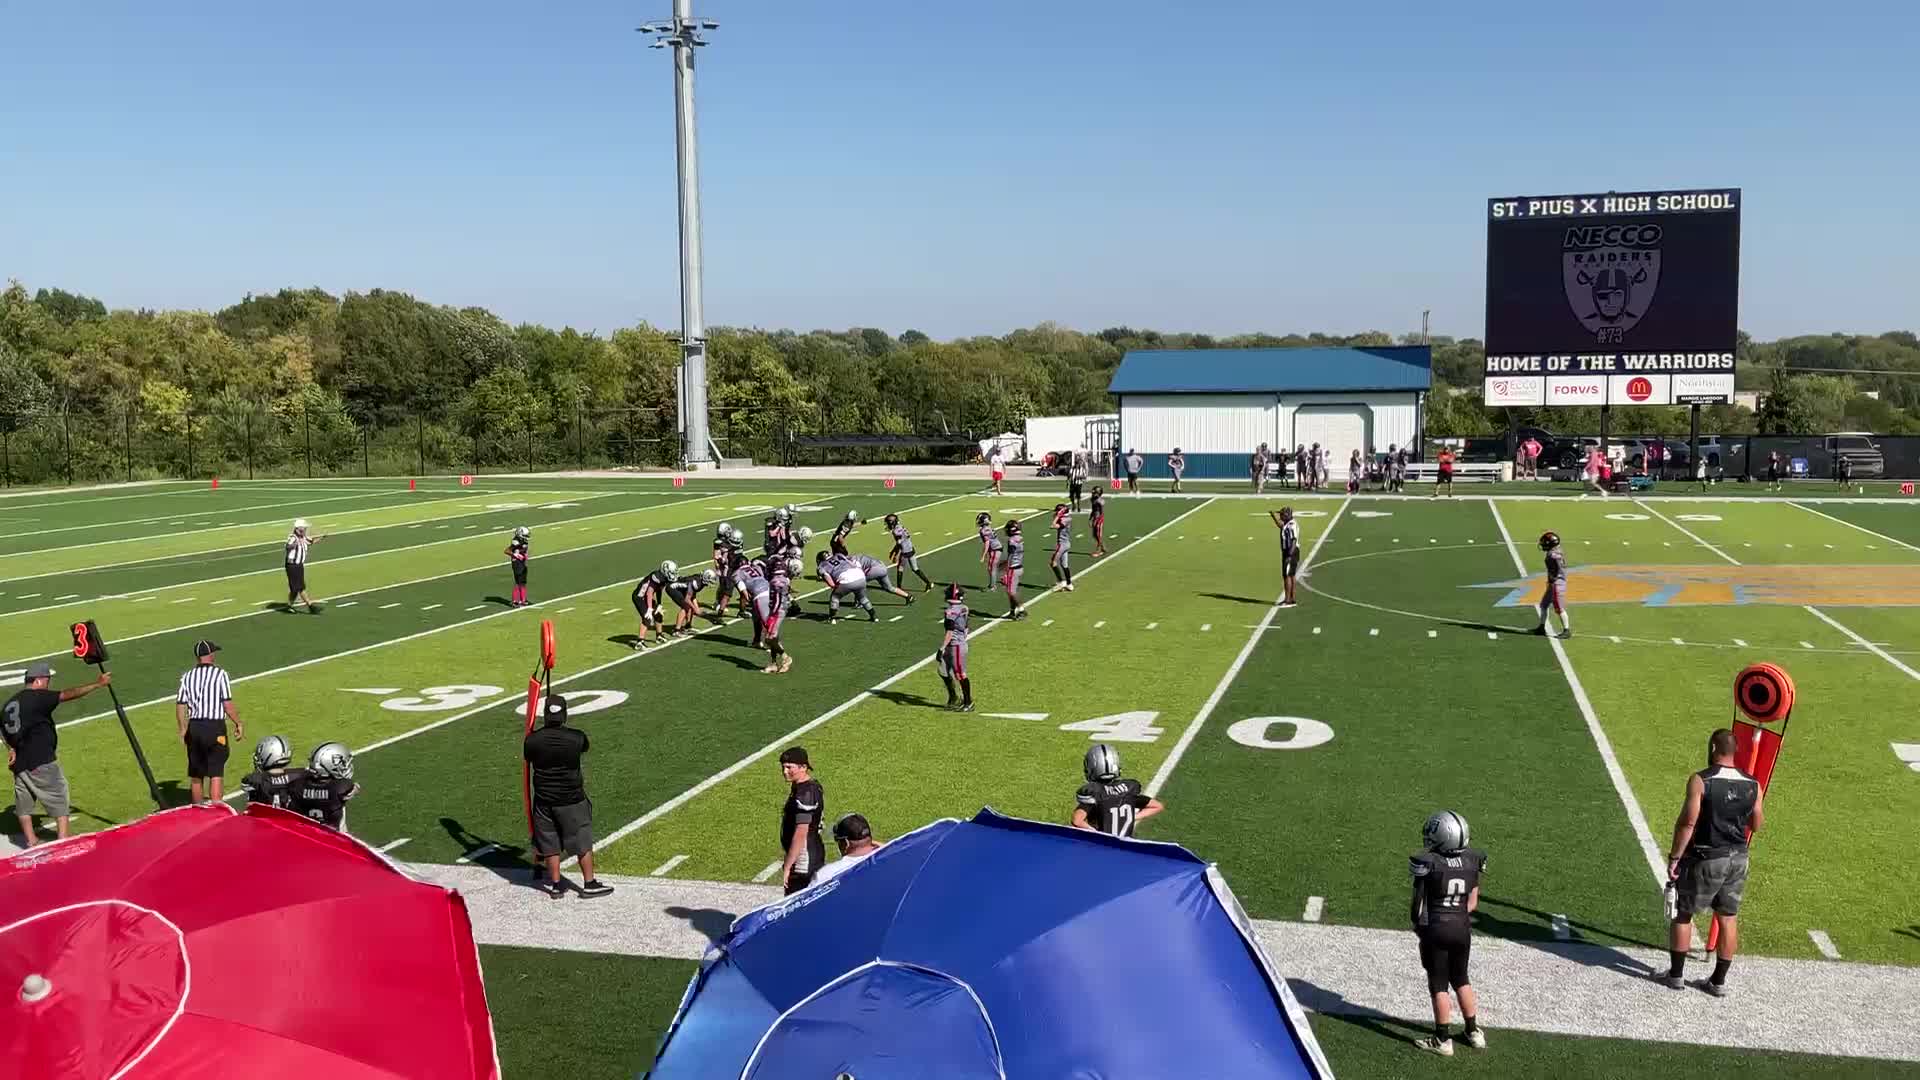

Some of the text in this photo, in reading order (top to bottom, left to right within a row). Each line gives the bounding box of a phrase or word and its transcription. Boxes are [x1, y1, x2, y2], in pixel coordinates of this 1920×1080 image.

[1493, 193, 1735, 217] ST. PIUS X HIGH SCHOOL
[1563, 224, 1662, 247] NECCO
[1574, 251, 1652, 263] RAIDERS
[1596, 327, 1623, 344] #73
[1486, 353, 1734, 371] HOME OF THE WARRIORS
[73, 623, 89, 657] 3
[4, 701, 21, 734] 3
[1110, 803, 1133, 838] 12
